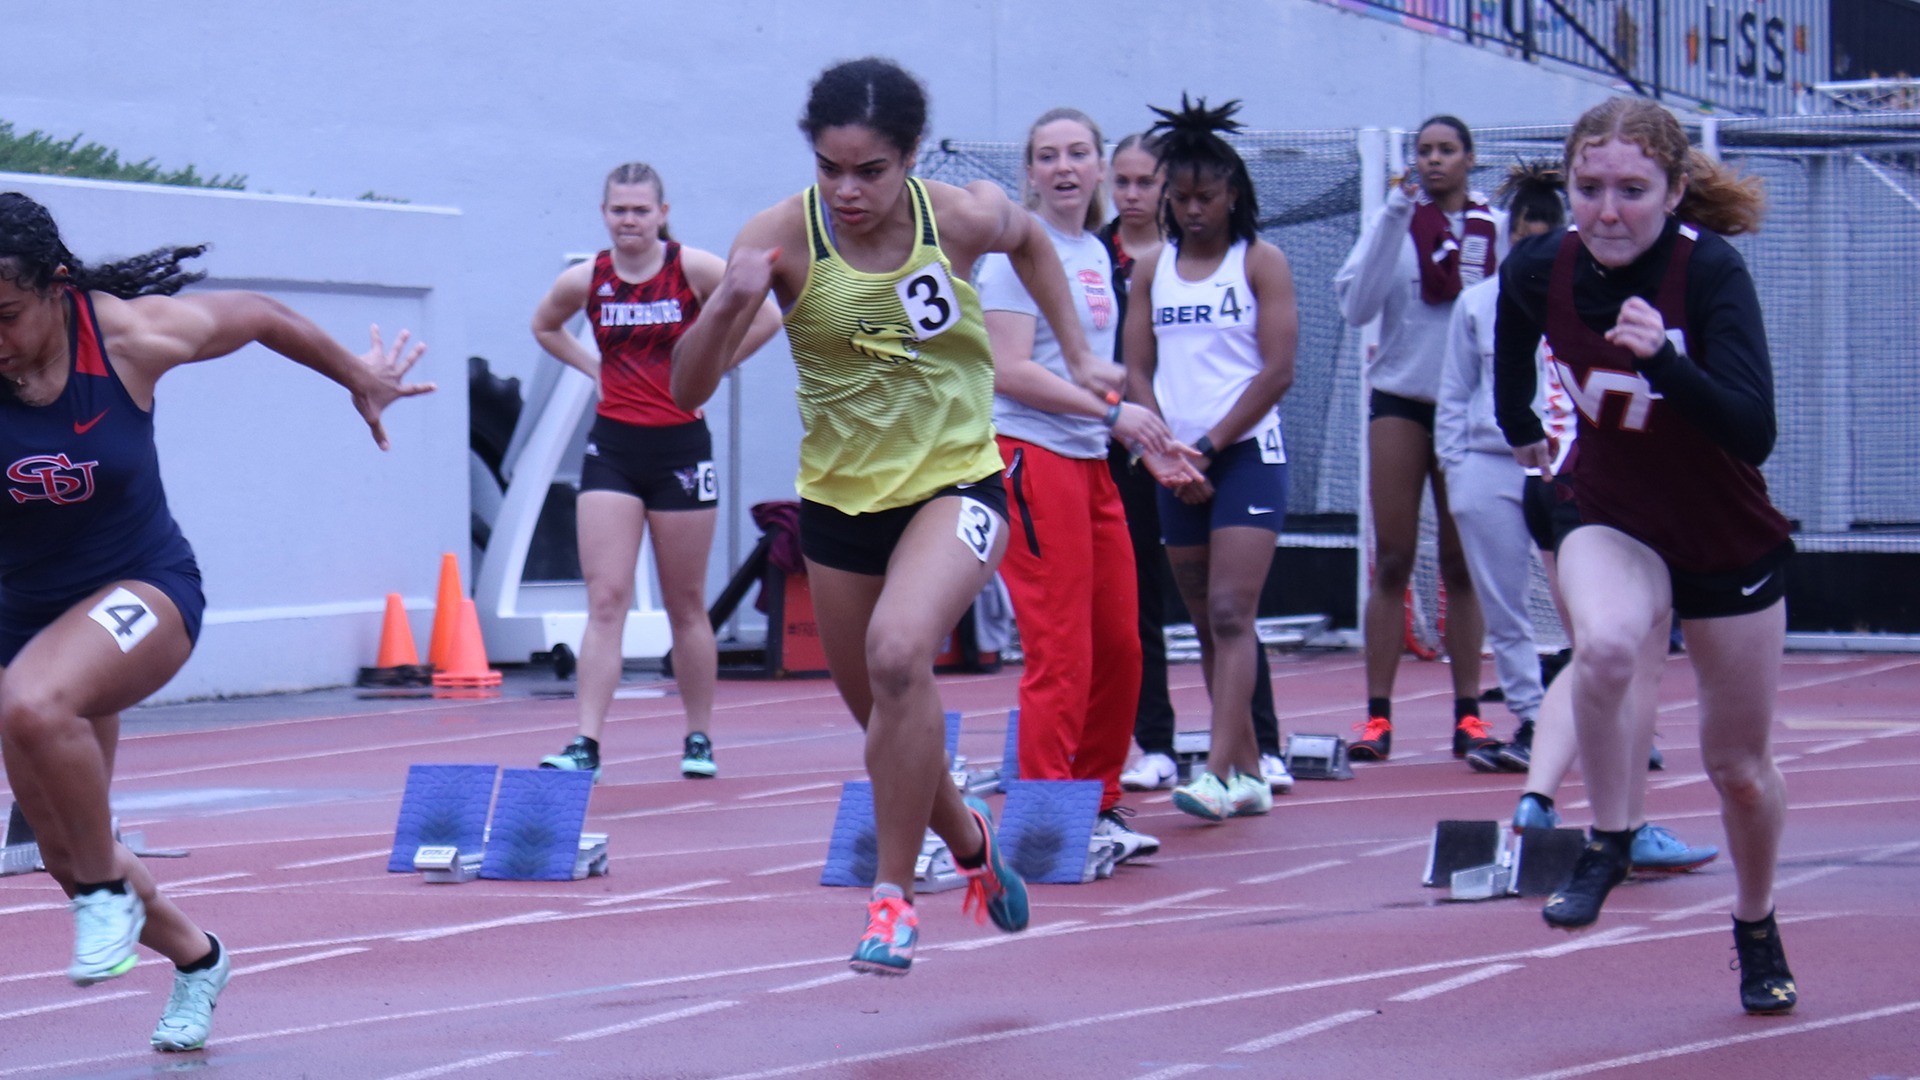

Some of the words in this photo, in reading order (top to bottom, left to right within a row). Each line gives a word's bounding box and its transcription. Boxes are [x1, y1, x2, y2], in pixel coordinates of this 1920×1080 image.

[1706, 6, 1785, 82] HSS
[600, 298, 682, 326] LYNCHBURG
[906, 274, 951, 331] 3
[1219, 286, 1242, 322] 4
[1265, 428, 1281, 460] 4
[6, 453, 99, 505] SU
[704, 467, 717, 493] 6
[963, 504, 991, 554] 3
[105, 603, 147, 637] 4
